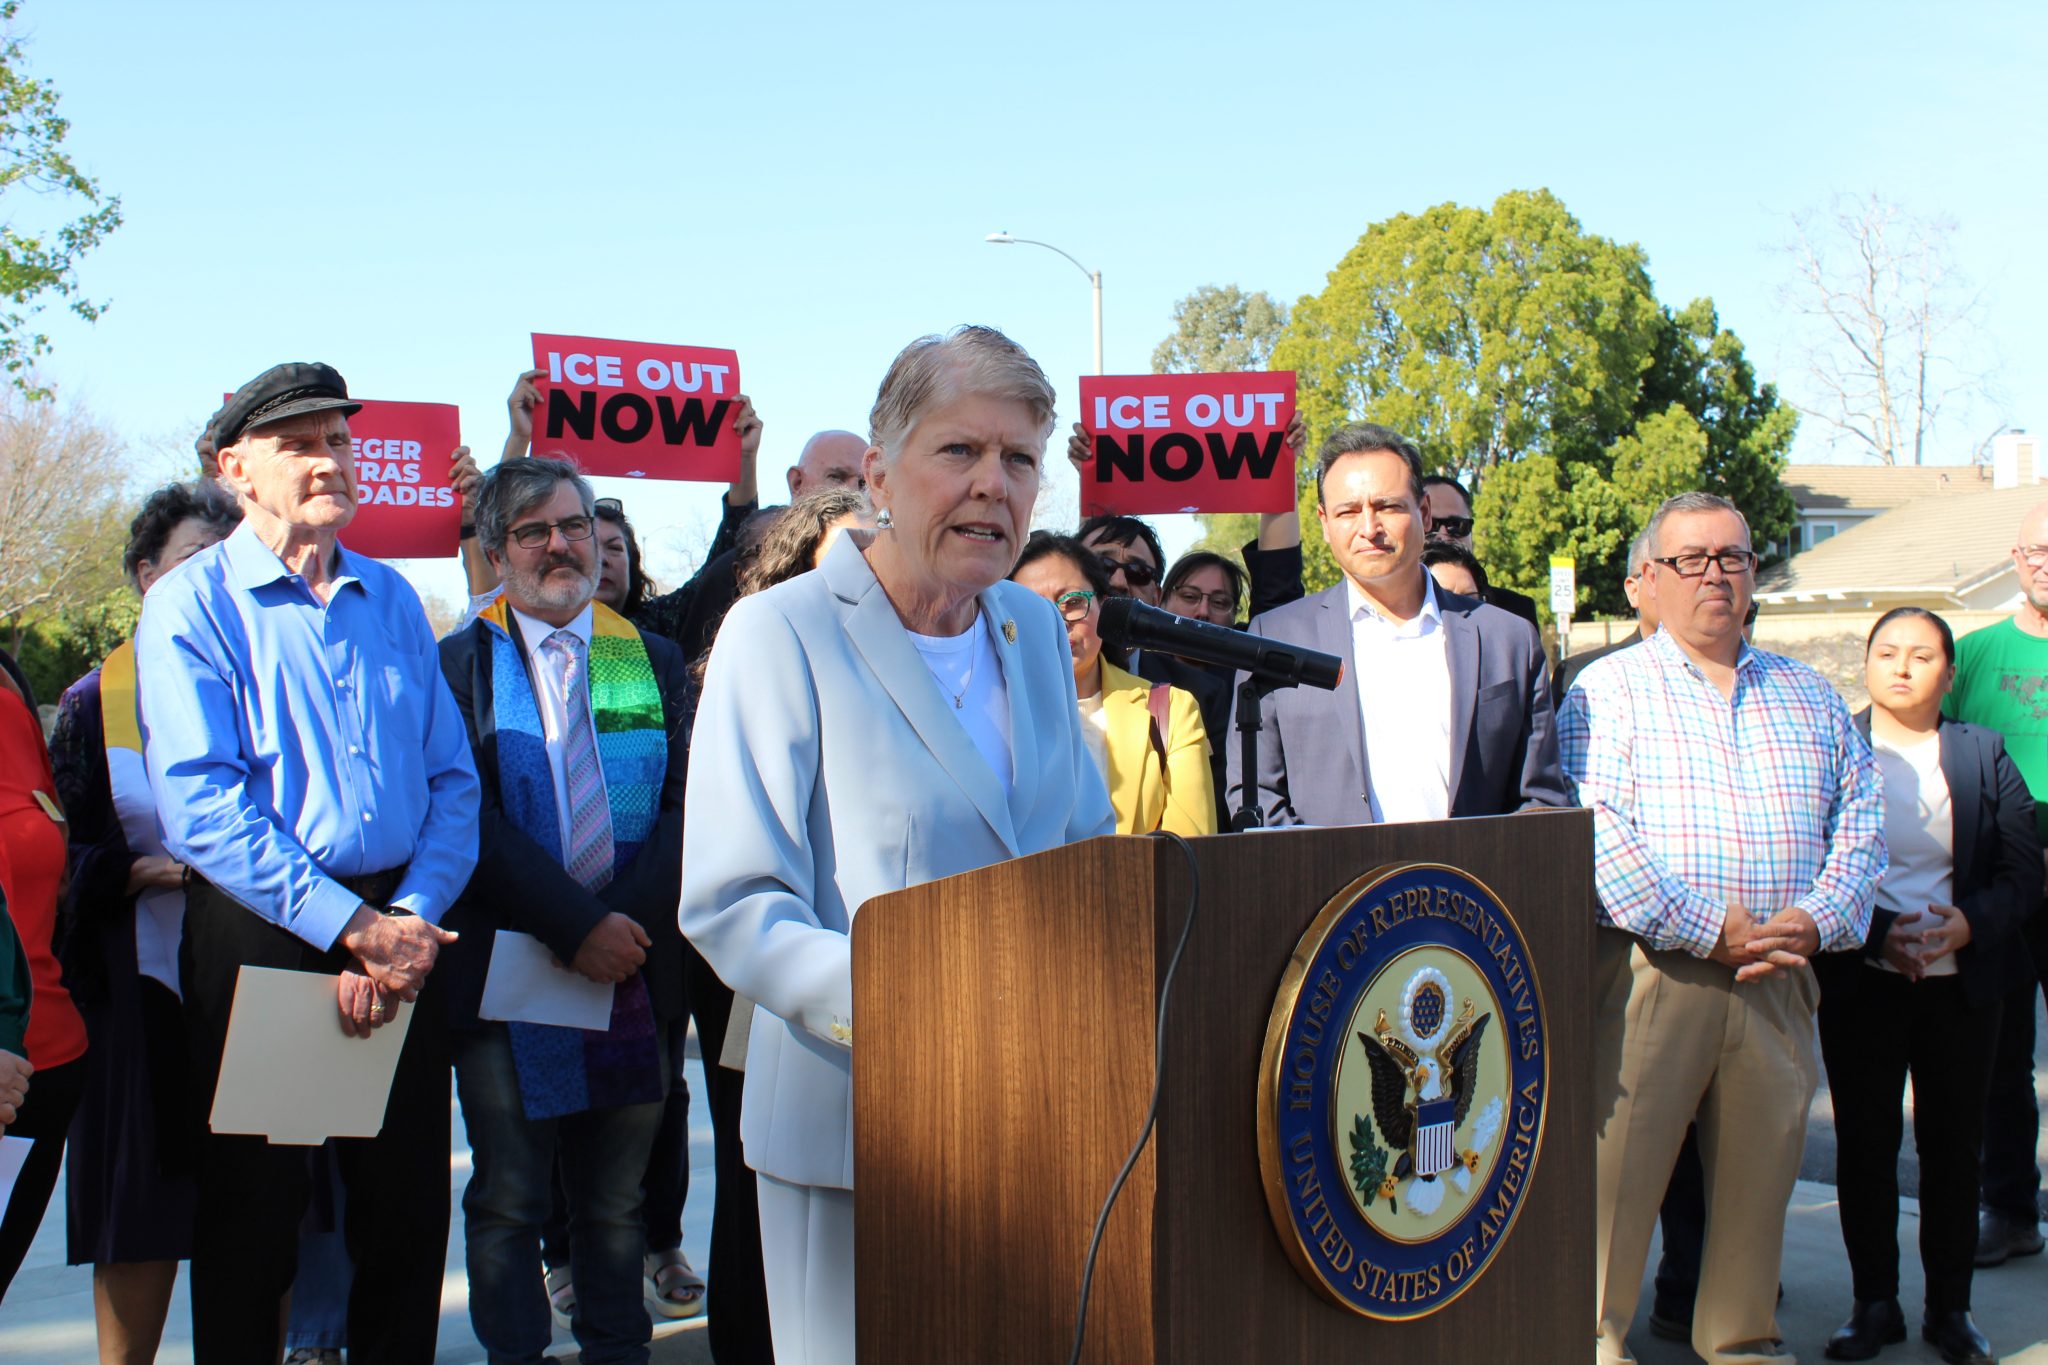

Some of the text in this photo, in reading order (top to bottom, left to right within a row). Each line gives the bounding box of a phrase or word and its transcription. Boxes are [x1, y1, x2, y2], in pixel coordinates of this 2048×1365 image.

[548, 352, 729, 394] ICE OUT
[546, 388, 731, 447] NOW
[1095, 393, 1284, 429] ICE OUT
[1096, 431, 1284, 483] NOW
[1554, 584, 1572, 597] 25
[1290, 887, 1539, 1111] HOUSE OF REPRESENTATIVES
[1291, 1078, 1538, 1302] UNITED STATES OF AMERICA
